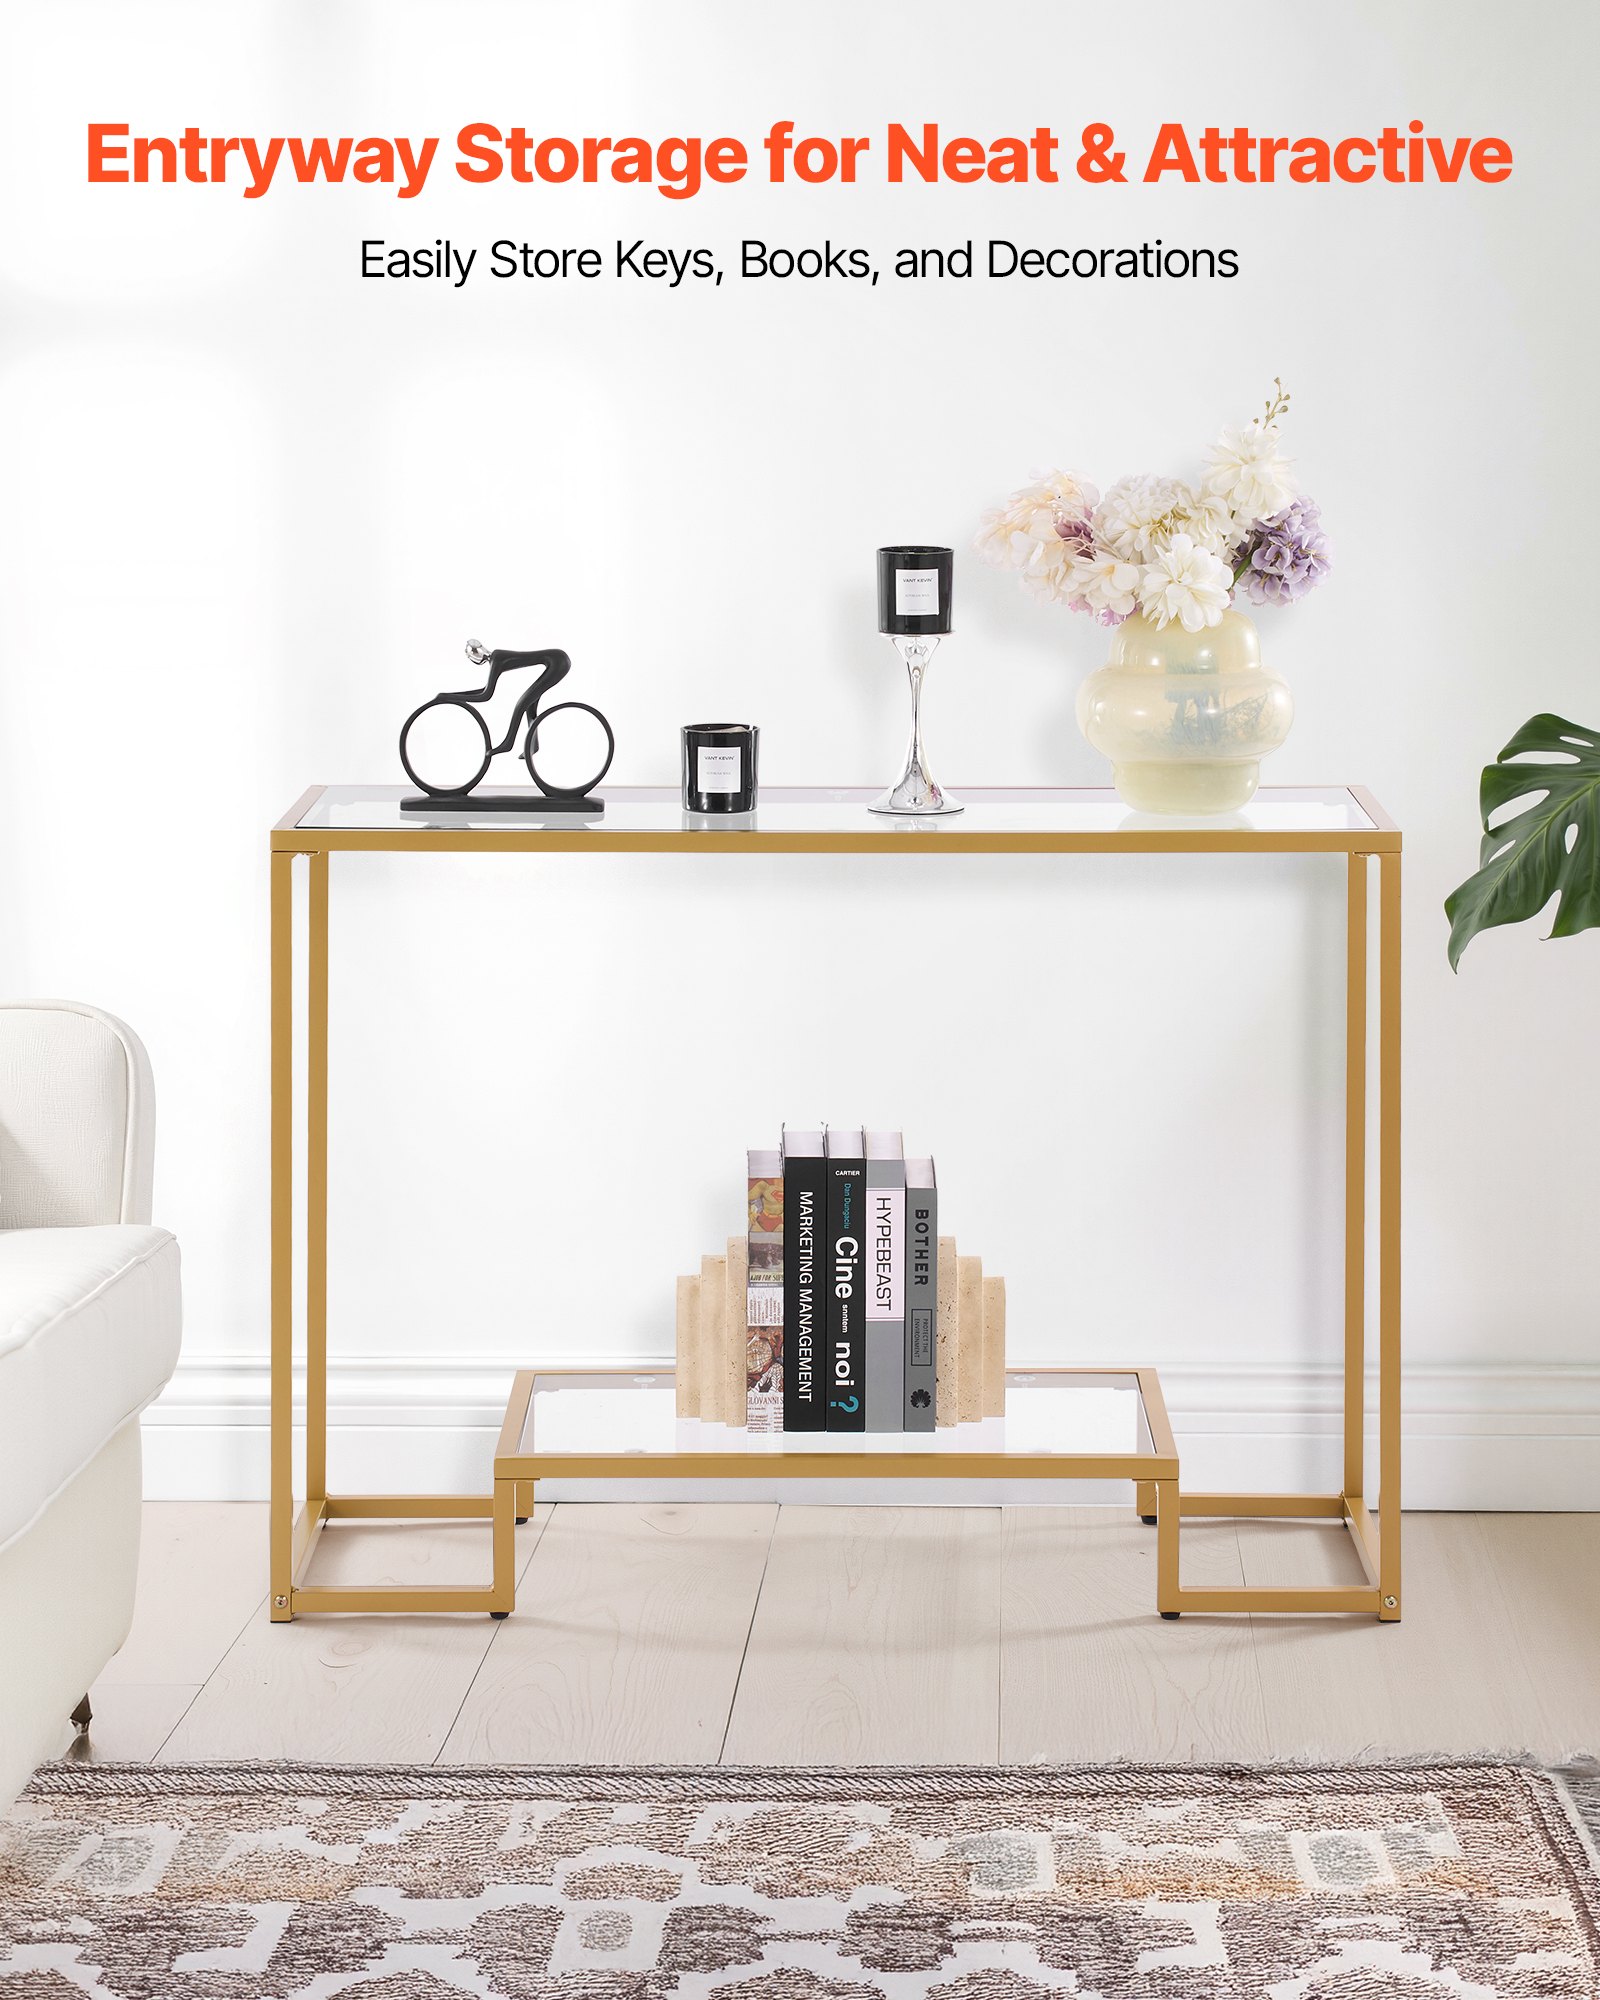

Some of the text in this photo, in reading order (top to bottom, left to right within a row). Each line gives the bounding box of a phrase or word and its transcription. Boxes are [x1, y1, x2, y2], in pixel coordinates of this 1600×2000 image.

[844, 1183, 852, 1196] Dan
[835, 1236, 859, 1299] Cine
[876, 1197, 892, 1311] HYPEBEAST
[914, 1209, 930, 1286] BOTHER
[798, 1191, 814, 1403] MARKETING MANAGEMENT
[834, 1342, 855, 1386] noi
[913, 1318, 921, 1358] ENVIRONMENT
[830, 1395, 859, 1414] ?
